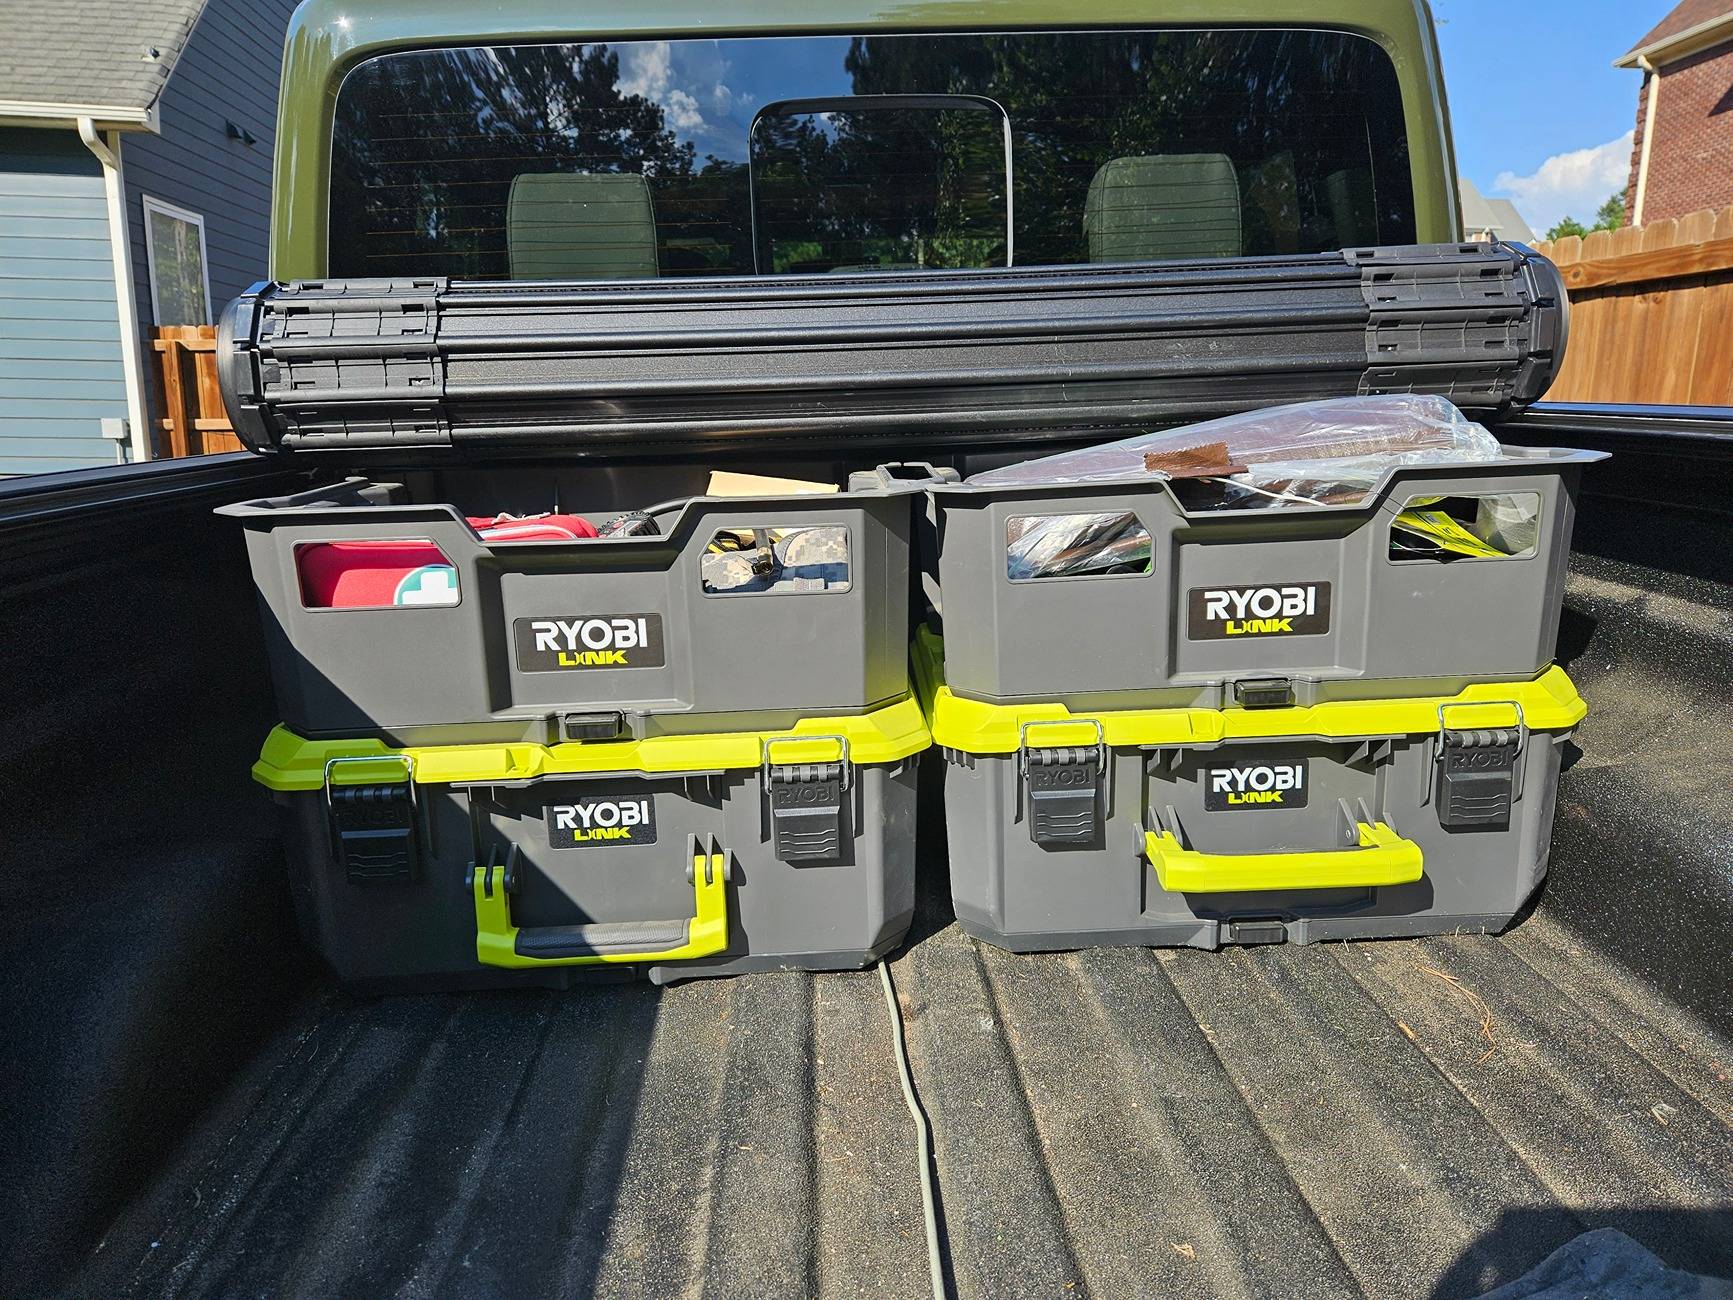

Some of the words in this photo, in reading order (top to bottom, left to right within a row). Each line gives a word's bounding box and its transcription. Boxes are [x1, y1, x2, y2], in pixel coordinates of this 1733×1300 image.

[1204, 586, 1316, 620] RYOBI
[532, 618, 648, 651] RYOBI
[1453, 751, 1508, 768] RYOBI
[1035, 768, 1092, 786] RYOBI
[1211, 765, 1302, 792] RYOBI
[777, 784, 837, 803] RYOBI
[554, 801, 649, 829] RYOBI
